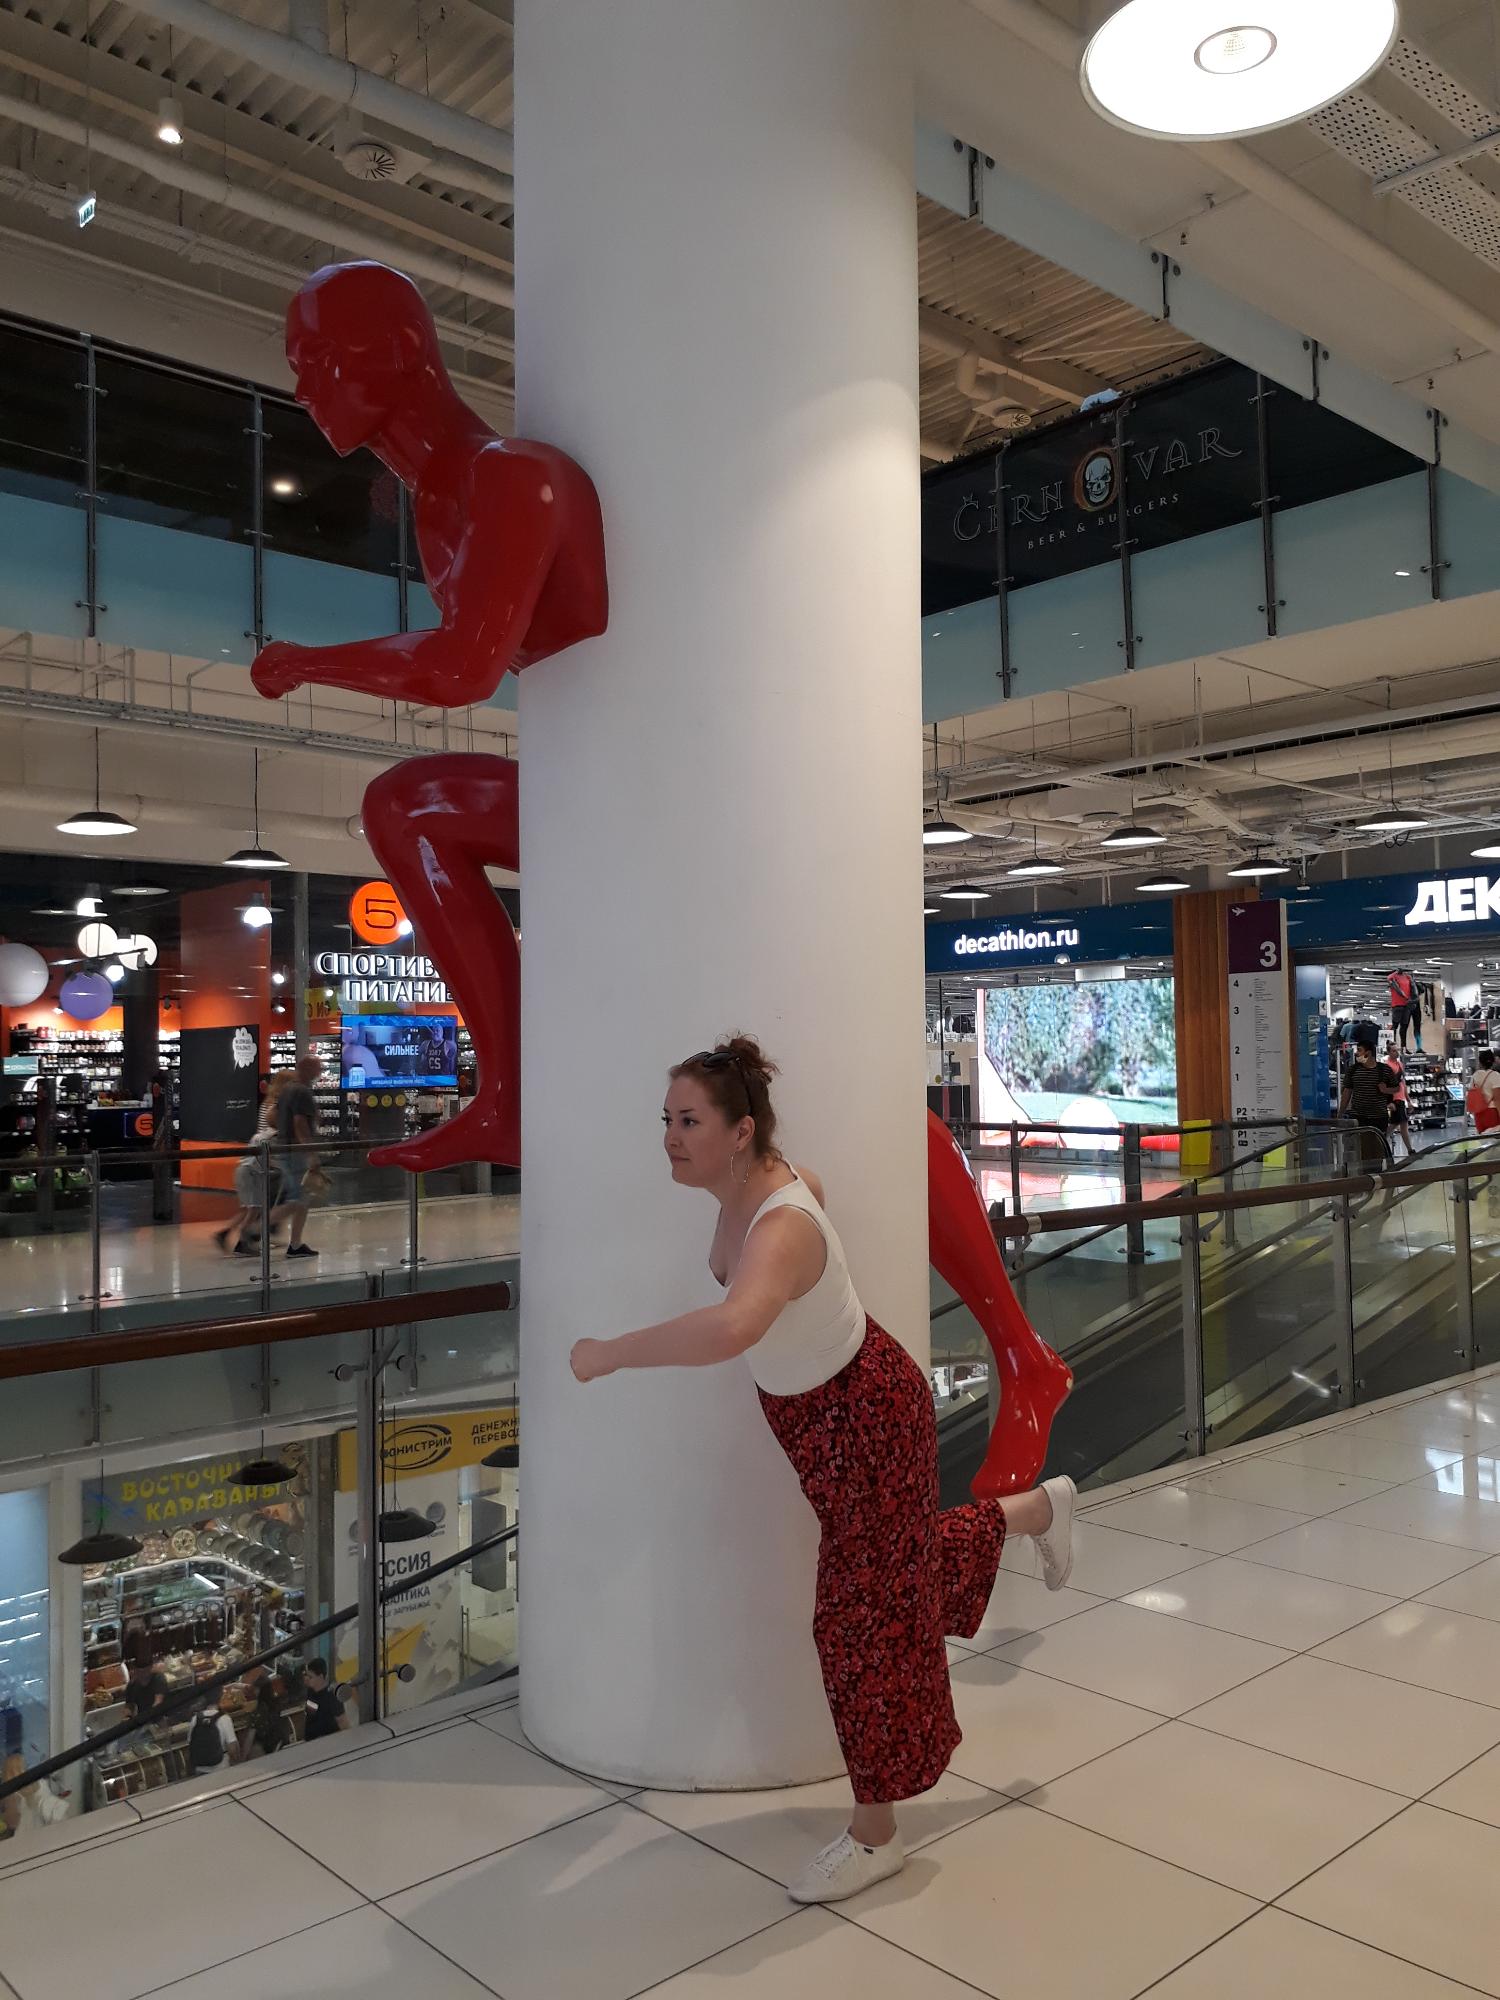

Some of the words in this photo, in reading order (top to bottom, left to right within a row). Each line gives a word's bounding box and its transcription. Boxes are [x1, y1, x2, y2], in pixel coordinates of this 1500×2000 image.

[1028, 530, 1067, 550] BEER
[1076, 522, 1086, 533] &
[1405, 876, 1500, 925] ДЕК
[366, 899, 397, 929] 5
[954, 929, 1079, 954] decathlon.ru
[1260, 941, 1277, 967] 3
[315, 951, 440, 978] СПОРТИВ
[1233, 1006, 1239, 1015] 3
[384, 1045, 419, 1056] СИЛЬНЕЕ
[1234, 1046, 1240, 1055] 2
[1236, 1107, 1247, 1116] P2
[1238, 1131, 1247, 1139] P1
[472, 1417, 519, 1436] ДЕНЕЖН
[121, 1458, 256, 1502] ВОСТОЧН
[383, 1551, 431, 1577] ССИЯ
